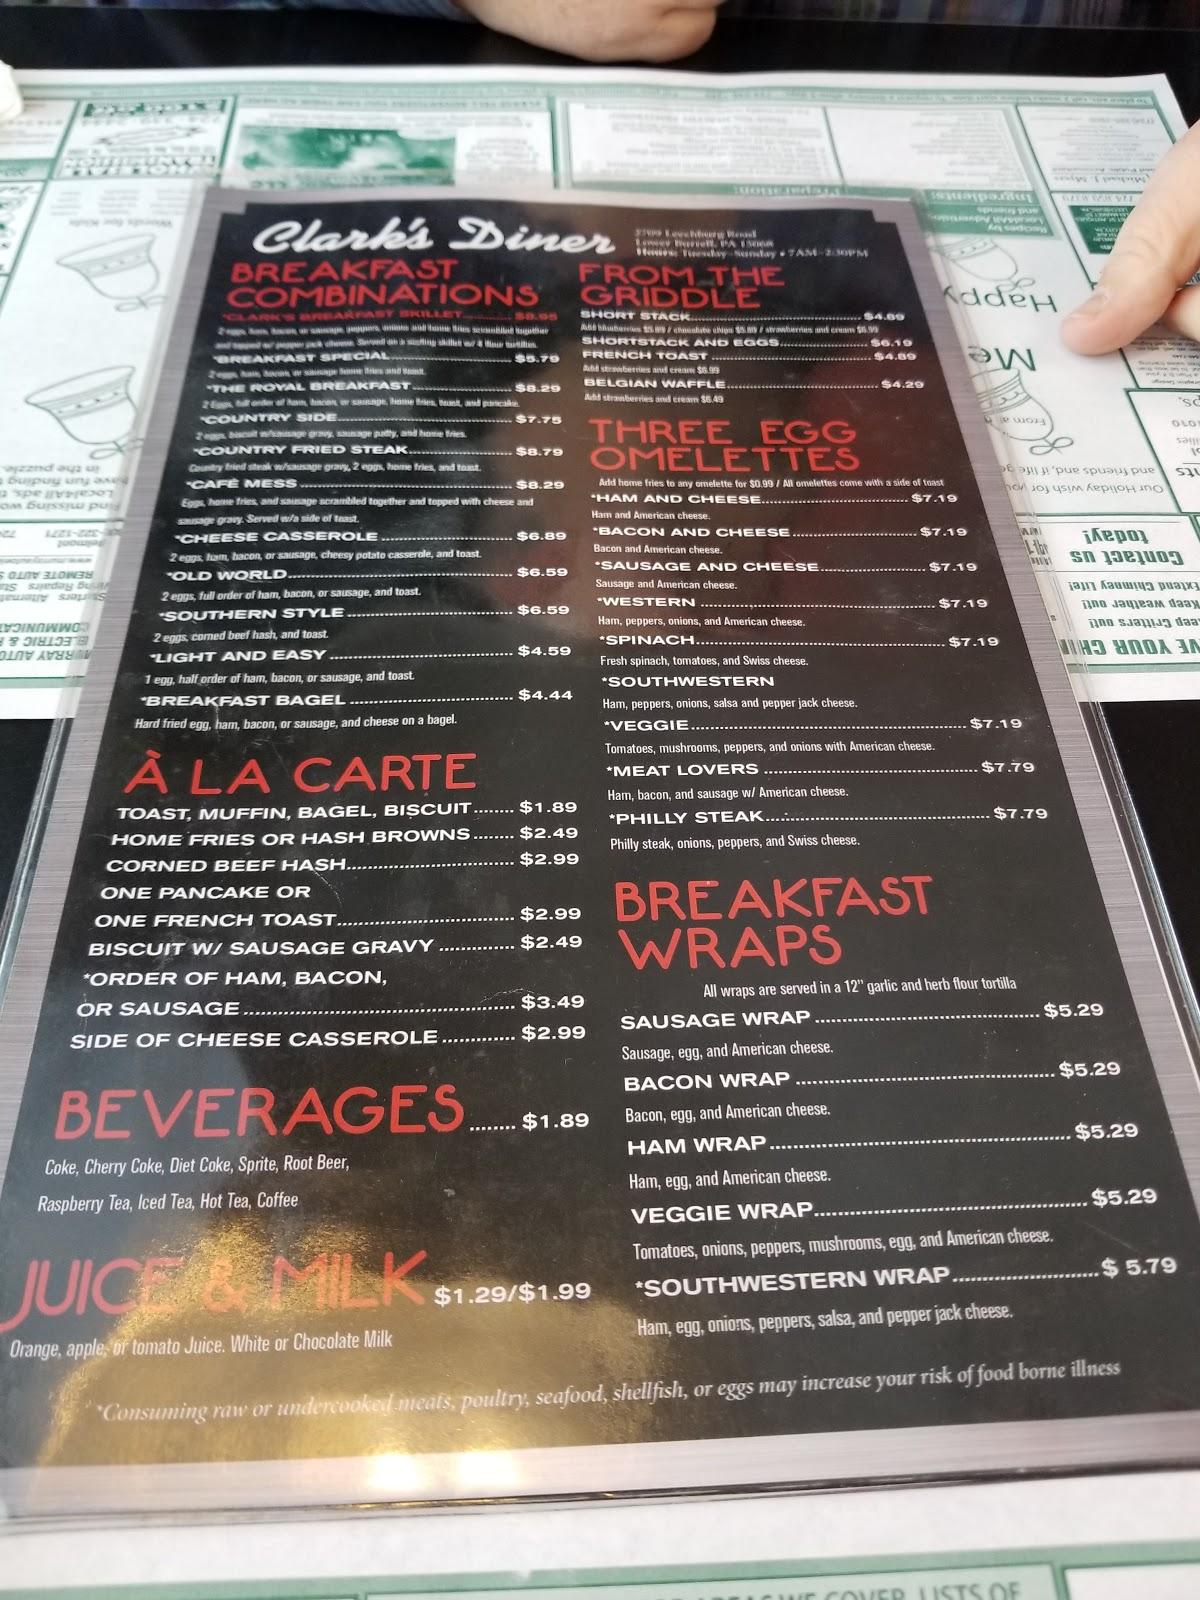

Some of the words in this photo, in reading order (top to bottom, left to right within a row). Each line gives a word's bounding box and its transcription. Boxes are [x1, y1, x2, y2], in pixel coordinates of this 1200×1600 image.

[253, 217, 434, 256] Clark's
[450, 217, 616, 255] Diner
[231, 258, 459, 281] BREAKFAST
[578, 263, 695, 286] FROM
[707, 265, 786, 286] THE
[226, 282, 540, 308] COMBINATIONS
[580, 286, 760, 309] GRIDDLE
[943, 286, 1058, 313] Happy
[580, 309, 636, 320] SHORT
[639, 311, 690, 322] STACK
[863, 311, 905, 322] $4.89
[319, 351, 390, 362] SPECIAL
[514, 353, 560, 364] $5.79
[583, 377, 658, 389] BELGIAN
[661, 379, 726, 389] WAFFLE
[880, 378, 925, 390] $4.29
[588, 418, 733, 445] THREE
[759, 419, 858, 443] EGG
[291, 444, 347, 455] FRIED
[350, 444, 408, 455] STEAK
[515, 445, 564, 457] $8.79
[590, 446, 861, 472] OMELETTES
[1031, 484, 1050, 494] for
[1052, 484, 1083, 494] wish
[1086, 482, 1136, 494] Holiday
[1138, 484, 1164, 494] Our
[643, 494, 683, 504] AND
[687, 494, 762, 505] CHEESE
[911, 492, 958, 504] $7.19
[262, 530, 378, 542] CASSEROLE
[516, 530, 567, 542] $6.89
[1082, 527, 1149, 545] today!
[1069, 550, 1096, 565] us
[1101, 550, 1184, 566] Contact
[595, 578, 635, 590] Sausage
[637, 579, 655, 589] and
[656, 579, 701, 590] American
[702, 579, 738, 590] cheese.
[1068, 581, 1096, 591] Life!
[1100, 580, 1155, 592] Chimney
[1081, 599, 1106, 610] out!
[1112, 599, 1164, 610] weather
[1088, 618, 1114, 628] out!
[1118, 618, 1172, 628] Critters
[948, 636, 1000, 649] $7.19
[1111, 639, 1172, 655] YOUR
[220, 650, 268, 662] AND
[271, 649, 327, 661] EASY
[517, 644, 572, 658] $4.59
[600, 655, 628, 666] Fresh
[629, 655, 670, 668] spinach,
[672, 655, 721, 667] tomatoes,
[722, 655, 741, 666] and
[742, 654, 771, 666] Swiss
[772, 655, 809, 666] cheese.
[275, 694, 346, 707] BAGEL
[518, 687, 573, 702] $4.44
[969, 717, 1023, 731] $7.19
[123, 749, 169, 794] À
[190, 758, 271, 796] LA
[292, 752, 477, 793] CARTE
[116, 807, 192, 822] TOAST,
[198, 807, 292, 821] MUFFIN,
[297, 804, 377, 819] BAGEL,
[384, 801, 472, 820] BISCUIT
[519, 799, 578, 815] $1.89
[111, 833, 183, 847] HOME
[188, 833, 256, 847] FRIES
[261, 833, 295, 846] OR
[300, 831, 365, 845] HASH
[371, 827, 471, 843] BROWNS
[519, 825, 579, 841] $2.49
[614, 875, 933, 923] BREAKFAST
[87, 942, 187, 957] BISCUIT
[191, 942, 223, 956] W/
[229, 941, 346, 956] SAUSAGE
[351, 938, 435, 955] GRAVY
[520, 933, 583, 951] $2.49
[617, 923, 843, 971] WRAPS
[703, 983, 718, 998] All
[720, 986, 756, 1000] wraps
[758, 985, 777, 996] are
[779, 980, 818, 995] served
[819, 980, 832, 994] in
[834, 983, 842, 994] a
[866, 978, 899, 996] garlic
[900, 977, 923, 992] and
[923, 977, 951, 991] herb
[952, 976, 979, 990] flour
[980, 976, 1018, 990] tortilla
[69, 1033, 129, 1050] SIDE
[135, 1032, 171, 1048] OF
[177, 1032, 281, 1048] CHEESE
[288, 1029, 438, 1048] CASSEROLE
[521, 1023, 586, 1043] $2.99
[55, 1083, 465, 1140] BEVERAGES
[522, 1111, 590, 1132] $1.89
[627, 1138, 687, 1156] HAM
[693, 1135, 767, 1153] WRAP
[1074, 1122, 1139, 1142] $5.29
[44, 1159, 79, 1177] Coke,
[84, 1158, 127, 1177] Cherry
[130, 1157, 165, 1175] Coke,
[169, 1156, 196, 1174] Diet
[199, 1156, 234, 1174] Coke,
[237, 1155, 279, 1176] Sprite,
[283, 1154, 314, 1171] Root
[316, 1153, 350, 1172] Beer,
[629, 1173, 662, 1191] Ham,
[665, 1175, 692, 1191] egg,
[695, 1170, 720, 1187] and
[722, 1169, 782, 1186] American
[784, 1167, 831, 1184] cheese.
[872, 1266, 951, 1286] WRAP
[0, 1256, 184, 1334] JUICE
[206, 1263, 249, 1311] &
[273, 1250, 428, 1310] MILK
[434, 1281, 592, 1308] $1.29/$1.99
[612, 1379, 689, 1404] shellfish,
[693, 1382, 712, 1397] or
[717, 1381, 755, 1401] eggs
[758, 1378, 798, 1397] may
[802, 1371, 872, 1391] increase
[876, 1371, 917, 1391] your
[921, 1365, 953, 1385] risk
[957, 1364, 976, 1386] of
[975, 1362, 1016, 1386] food
[1019, 1360, 1067, 1380] borne
[1070, 1358, 1121, 1378] illness
